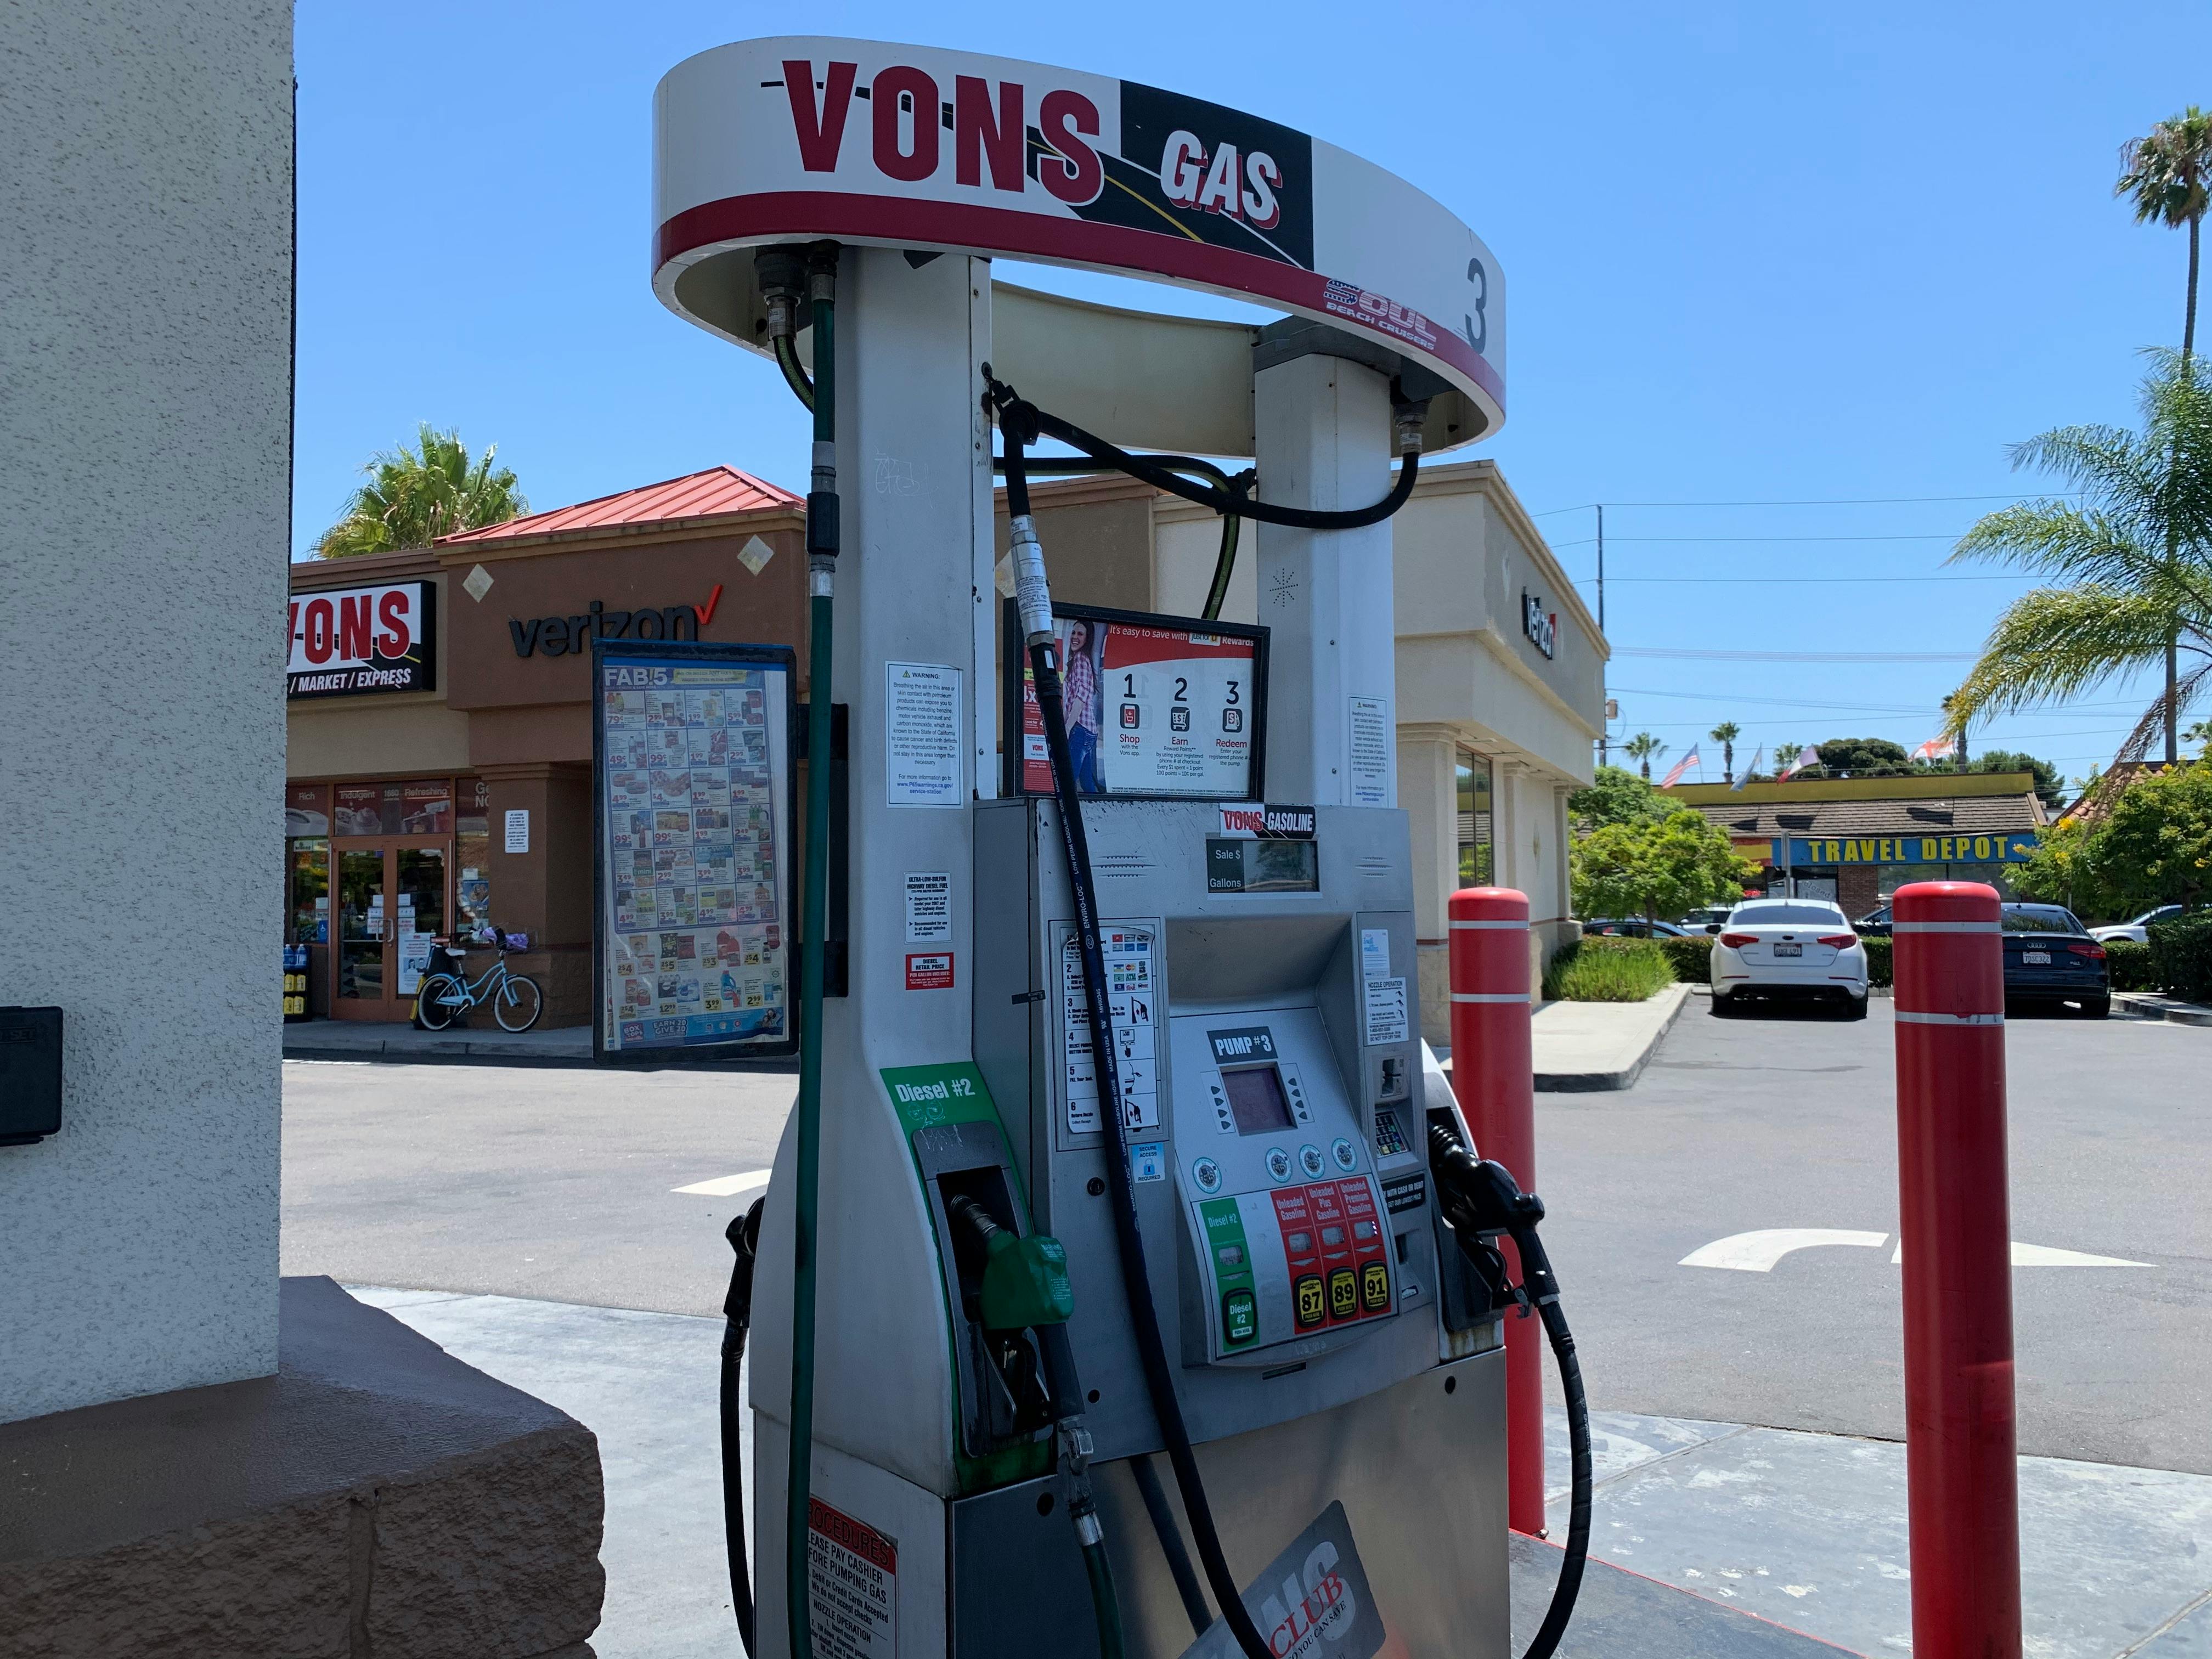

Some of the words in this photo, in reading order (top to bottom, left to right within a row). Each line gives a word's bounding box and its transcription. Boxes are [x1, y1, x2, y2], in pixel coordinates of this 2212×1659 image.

[782, 60, 1102, 204] VONS
[1161, 129, 1282, 230] GAS
[1465, 258, 1487, 354] 3
[1326, 302, 1374, 324] BEACH
[1378, 320, 1435, 350] CRUISERS
[509, 601, 699, 658] verizon
[1110, 625, 1120, 635] It's
[1122, 628, 1140, 638] easy
[1172, 631, 1188, 640] with
[1222, 637, 1254, 646] Rewards
[298, 673, 347, 692] MARKET
[357, 668, 411, 687] EXPRESS
[1124, 674, 1136, 698] 1
[1174, 678, 1187, 701] 2
[1226, 681, 1239, 704] 3
[1119, 734, 1140, 744] Shop
[1172, 737, 1188, 745] Earn
[1216, 739, 1247, 748] Redeem
[340, 791, 375, 800] Indulgent
[404, 788, 447, 797] Refreshing
[1224, 810, 1263, 832] VONS
[1268, 812, 1313, 831] GASOLINE
[1216, 850, 1233, 859] Sale
[1235, 850, 1240, 860] $
[1808, 839, 1905, 862] TRAVEL
[1922, 837, 2008, 860] DEPOT
[1210, 878, 1242, 888] Gallons
[1066, 964, 1071, 973] 2
[1068, 998, 1073, 1007] 3
[624, 1025, 641, 1034] BOX
[656, 1026, 674, 1034] GIVE
[1069, 1032, 1074, 1041] 4
[1215, 1036, 1253, 1056] PUMP
[1070, 1066, 1075, 1075] 5
[895, 1081, 950, 1102] Diesel
[952, 1078, 975, 1097] #2
[1071, 1102, 1076, 1111] 6
[1309, 1186, 1334, 1198] Unleaded
[1340, 1181, 1367, 1193] Unleaded
[1276, 1196, 1305, 1210] Unleaded
[1318, 1198, 1332, 1208] Plus
[1344, 1192, 1370, 1204] Premium
[1280, 1208, 1306, 1220] Gasoline
[1317, 1208, 1340, 1220] Gasoline
[1348, 1203, 1372, 1215] Gasoline
[1207, 1214, 1228, 1228] Diesel
[1335, 1283, 1353, 1303] 89
[1367, 1277, 1385, 1296] 91
[1230, 1302, 1251, 1314] Diesel
[1302, 1291, 1320, 1311] 87
[1237, 1314, 1246, 1324] #2
[831, 1544, 845, 1562] PAY
[848, 1554, 883, 1585] CASHIER
[830, 1560, 866, 1592] PUMPING
[870, 1583, 887, 1604] GAS
[812, 1581, 820, 1591] We
[837, 1598, 853, 1613] accept
[854, 1608, 872, 1625] checks
[832, 1581, 847, 1598] Credit
[848, 1592, 862, 1607] Cards
[864, 1601, 888, 1623] Accepted
[814, 1599, 835, 1620] NOZZLE
[837, 1615, 871, 1643] OPERATION
[1269, 1571, 1343, 1659] CLUB
[1299, 1635, 1314, 1655] YOU
[1314, 1619, 1329, 1638] CAN
[1329, 1601, 1346, 1623] SAVE
